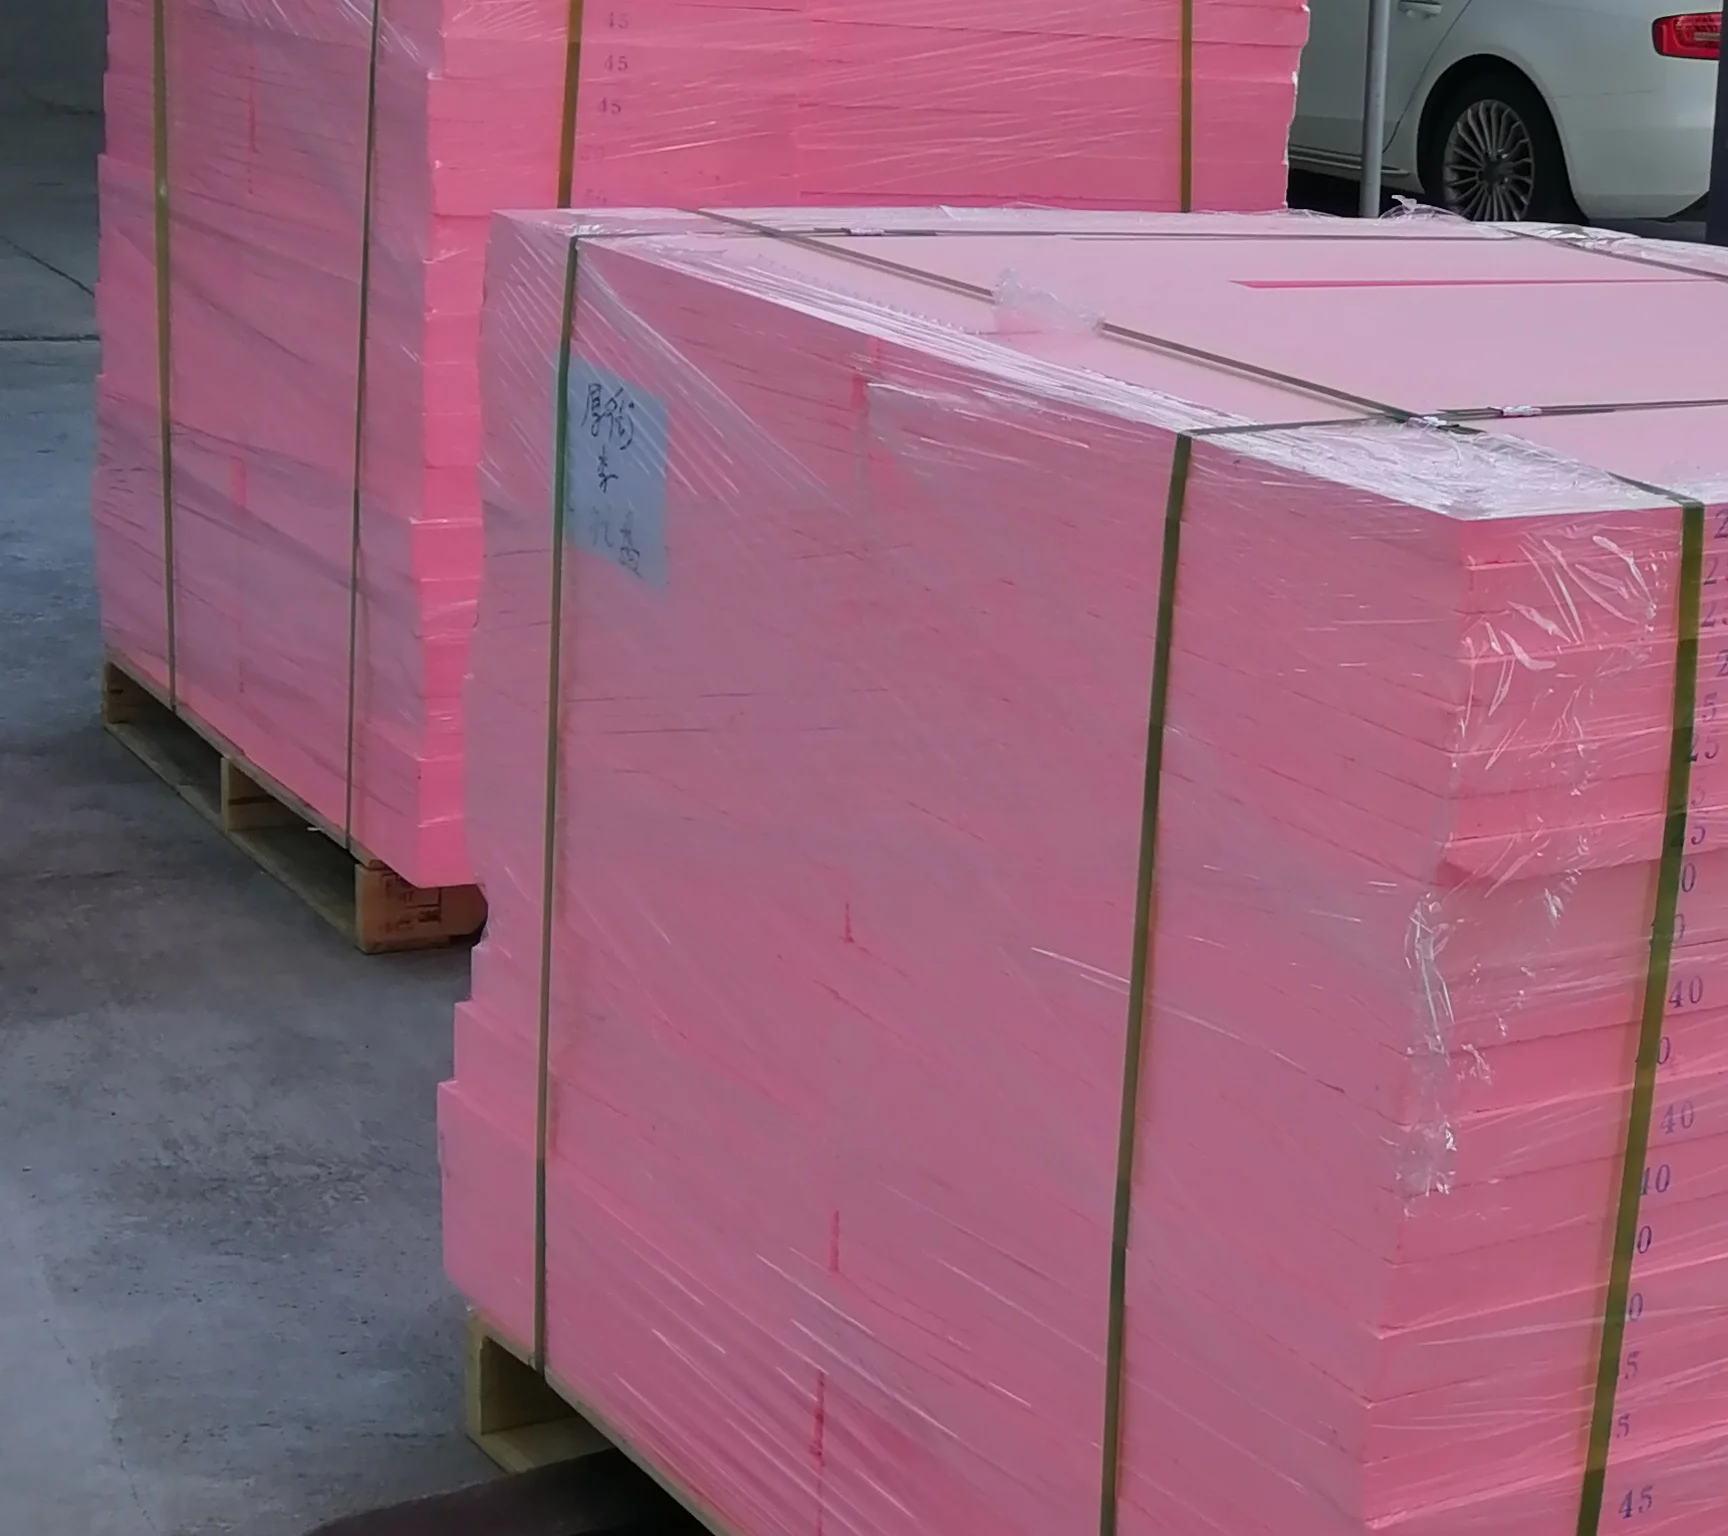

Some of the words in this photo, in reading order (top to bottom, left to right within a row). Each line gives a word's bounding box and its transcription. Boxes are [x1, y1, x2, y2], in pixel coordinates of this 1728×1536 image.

[1669, 976, 1703, 1008] 40
[1660, 1101, 1695, 1135] 40
[1618, 1484, 1653, 1519] 45
